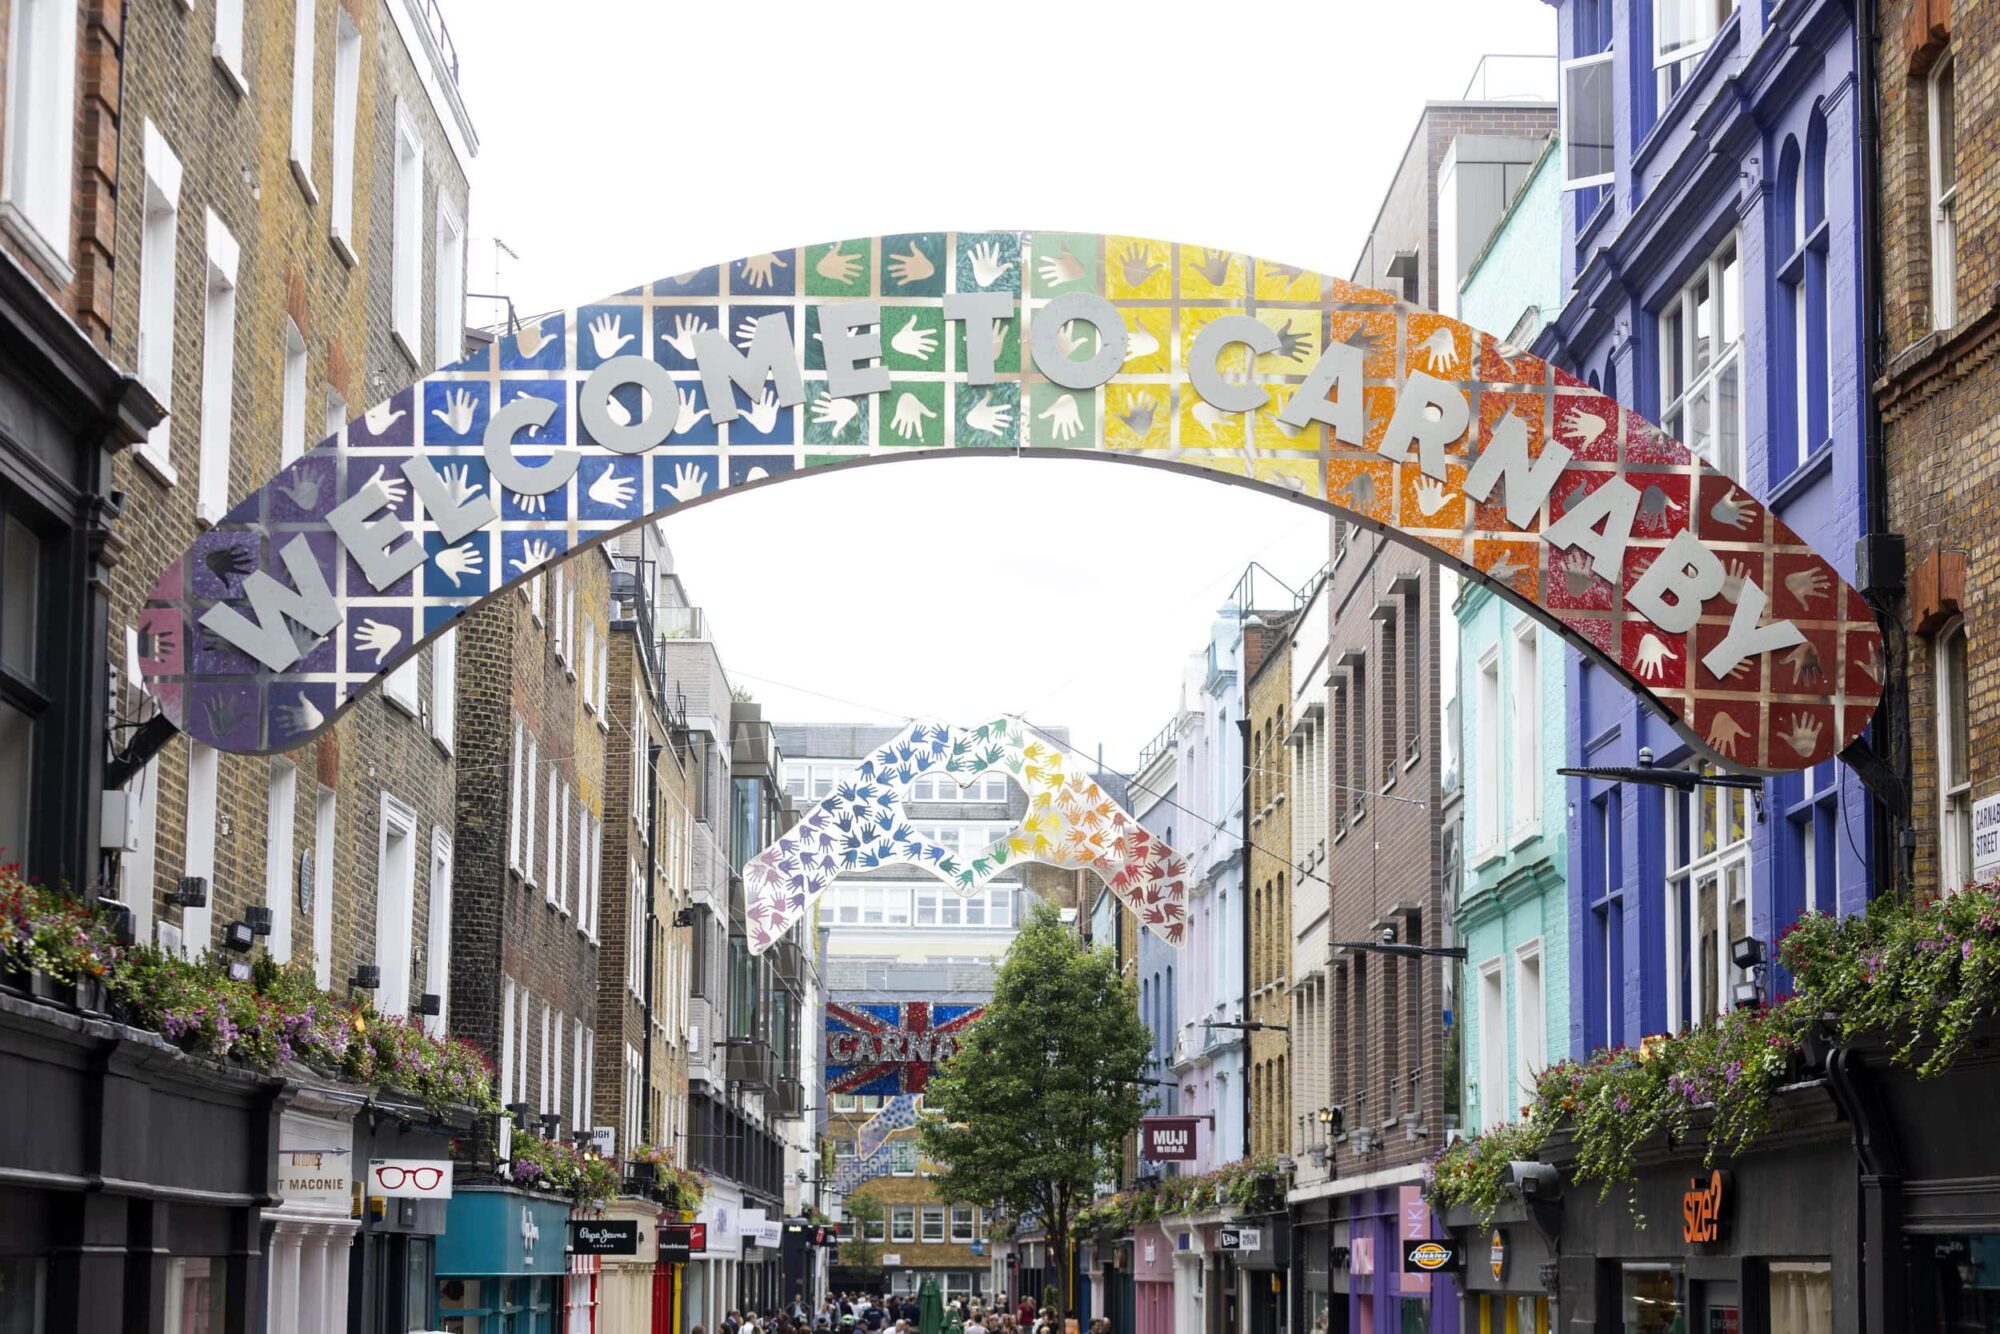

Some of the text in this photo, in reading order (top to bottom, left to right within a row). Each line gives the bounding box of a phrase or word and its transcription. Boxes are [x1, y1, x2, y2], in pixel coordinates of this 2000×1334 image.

[198, 290, 1807, 680] WELCOME TO CARNABY
[1976, 831, 1998, 857] STREET
[1153, 1130, 1188, 1145] MUJI
[289, 1178, 344, 1191] MACONIE
[1683, 1169, 1722, 1243] size?
[579, 1227, 627, 1243] Pepe Jeans
[1414, 1252, 1447, 1260] Dickies
